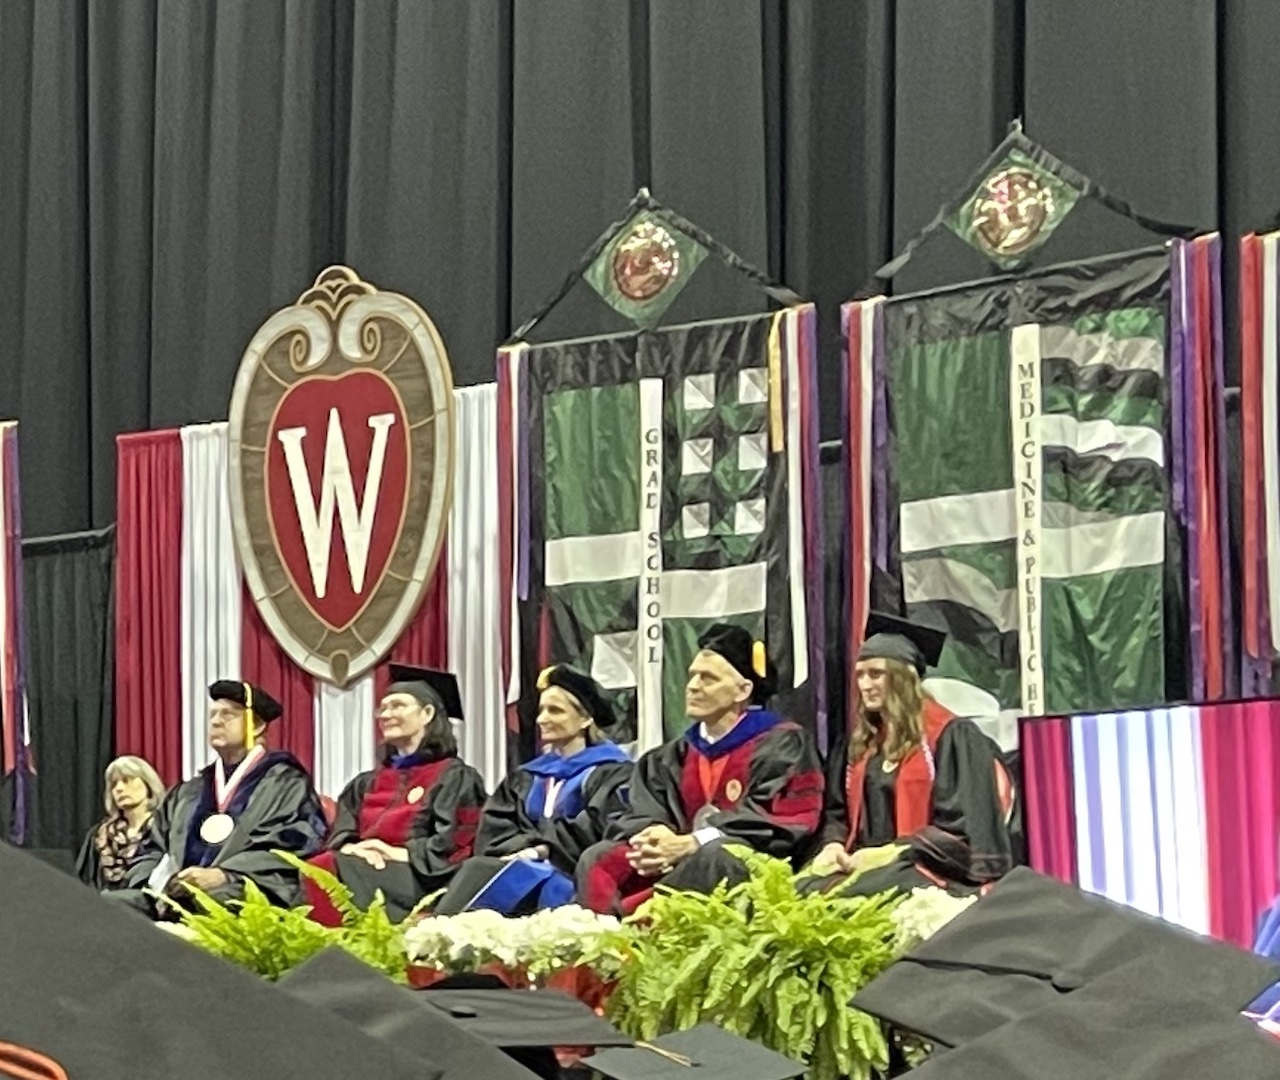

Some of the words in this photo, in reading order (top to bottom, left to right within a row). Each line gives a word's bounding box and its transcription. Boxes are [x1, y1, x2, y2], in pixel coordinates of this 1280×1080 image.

[277, 407, 396, 599] W
[644, 428, 660, 509] GRAD
[1018, 361, 1037, 519] MEDICINE
[646, 532, 661, 664] SCHOOL
[1025, 556, 1037, 673] PUBLIC
